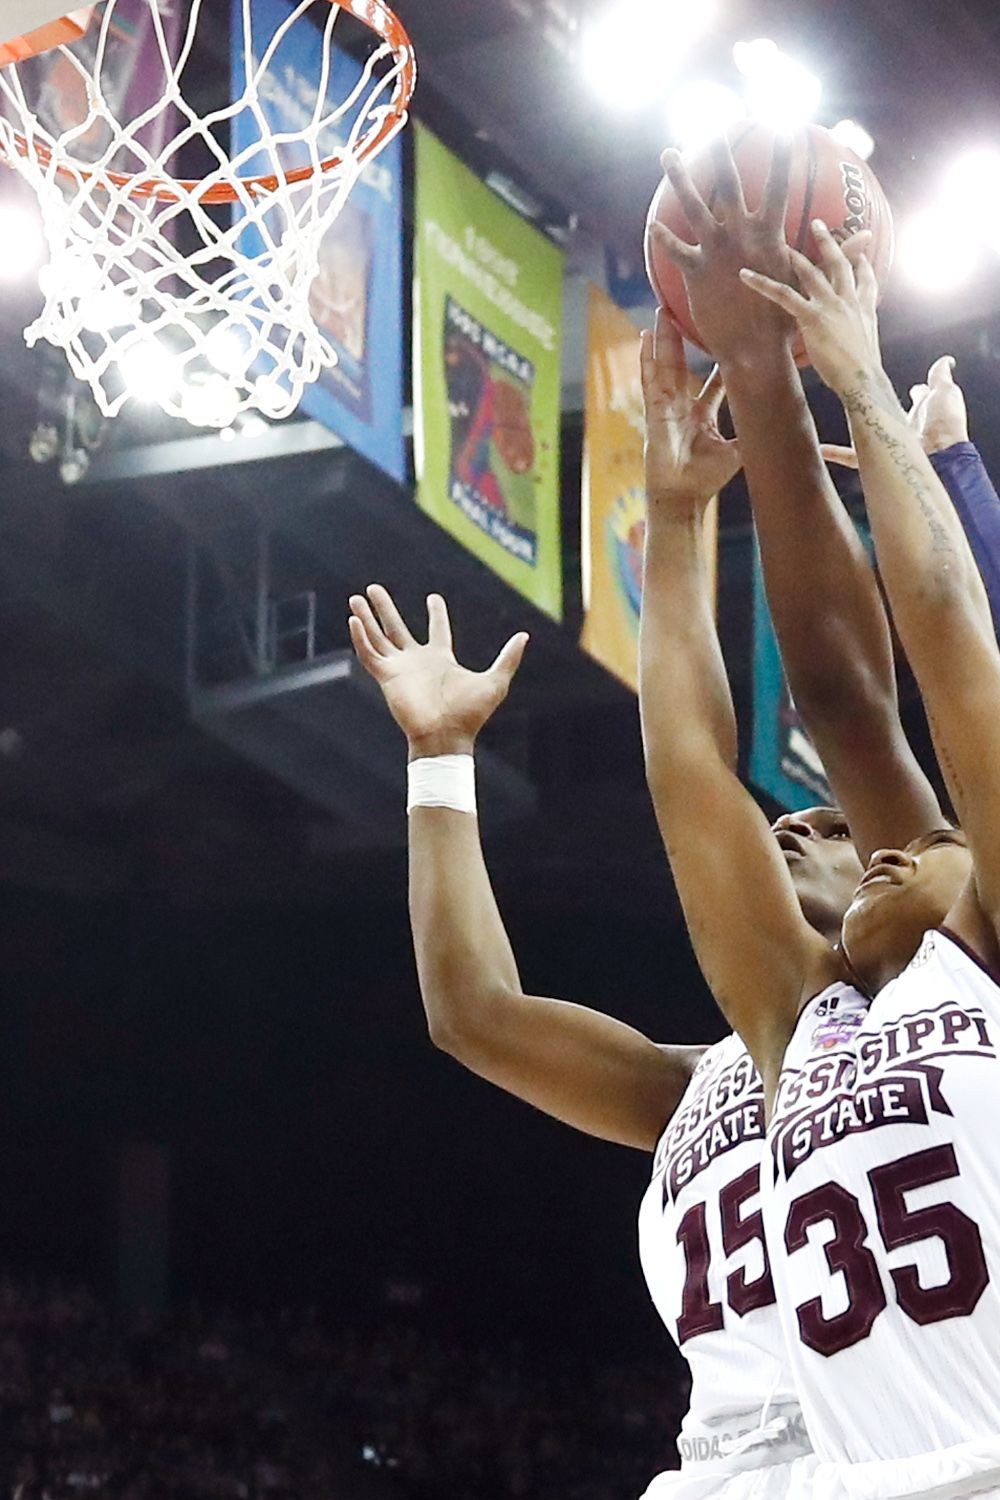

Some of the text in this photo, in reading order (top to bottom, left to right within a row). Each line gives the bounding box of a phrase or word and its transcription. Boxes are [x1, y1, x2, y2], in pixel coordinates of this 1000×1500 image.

[782, 1010, 994, 1110] SSISIPPI
[675, 1105, 761, 1185] STATE
[791, 1083, 910, 1160] STATE
[676, 1162, 777, 1347] 15
[784, 1142, 990, 1358] 35
[680, 1433, 732, 1462] DIDA
